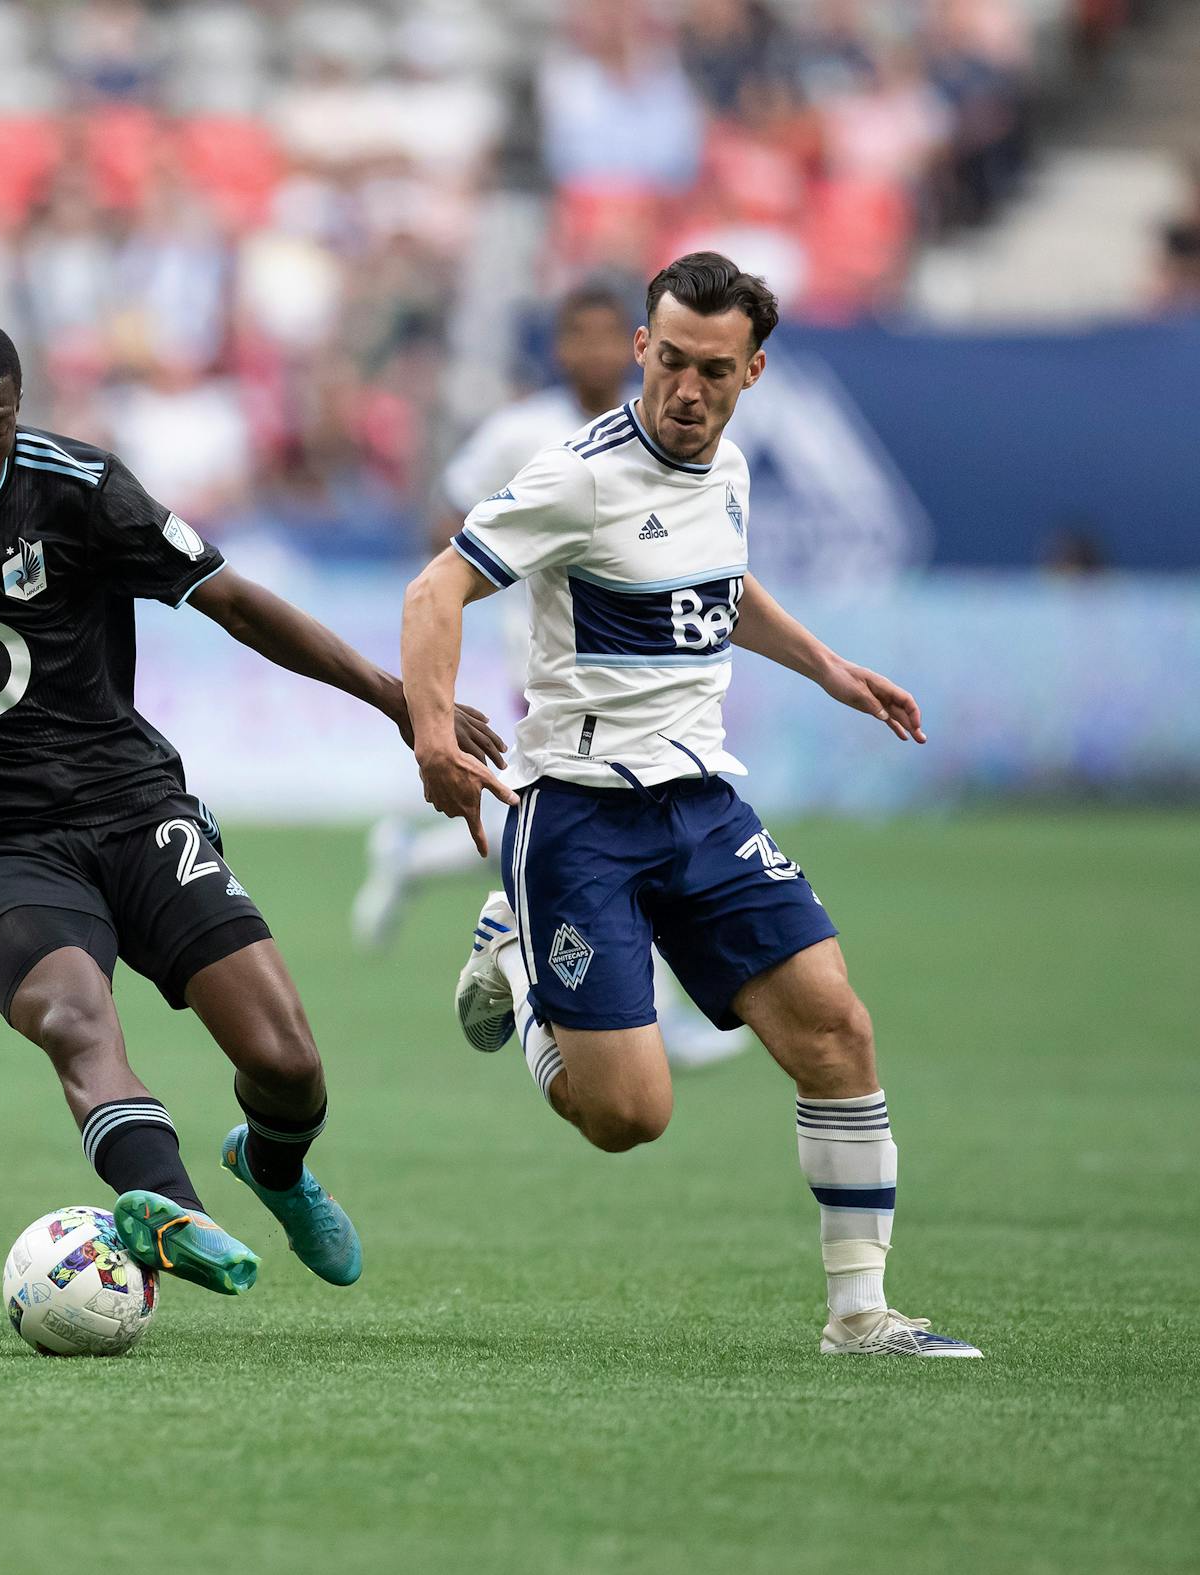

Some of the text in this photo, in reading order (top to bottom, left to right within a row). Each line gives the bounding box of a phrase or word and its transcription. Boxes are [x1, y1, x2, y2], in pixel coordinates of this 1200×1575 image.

[638, 529, 669, 540] adidas
[155, 819, 221, 887] 2
[225, 886, 250, 898] adid
[552, 950, 589, 964] WHITECAPS
[566, 960, 575, 968] FC
